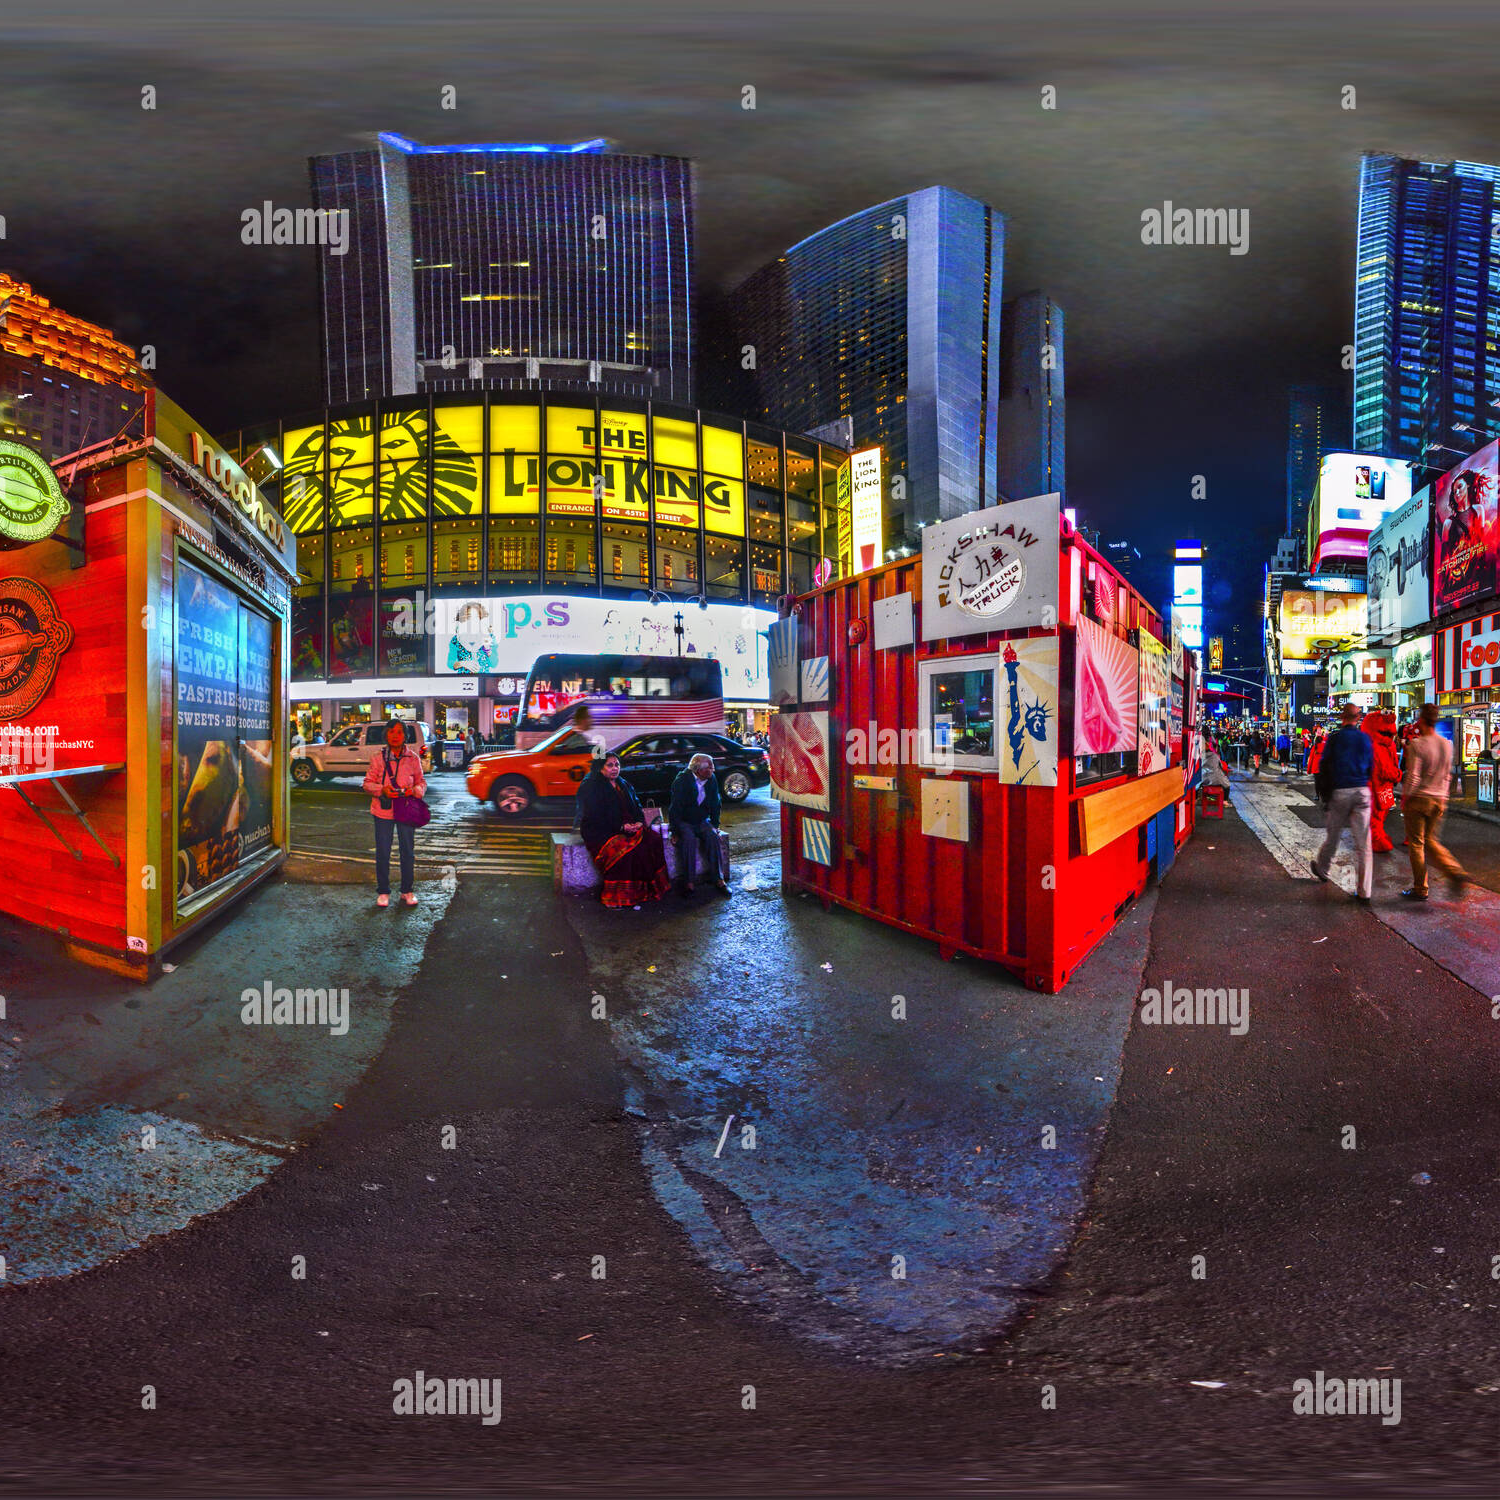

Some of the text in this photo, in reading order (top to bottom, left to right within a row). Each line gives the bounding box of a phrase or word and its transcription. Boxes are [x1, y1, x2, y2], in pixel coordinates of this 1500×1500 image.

[576, 426, 646, 450] THE
[855, 467, 877, 482] LION
[858, 459, 873, 468] THE
[503, 447, 731, 508] LION KING
[854, 479, 880, 493] KING
[190, 431, 287, 554] nuchas
[551, 504, 681, 522] ENTRANCE ON 45TH STREET
[973, 575, 1020, 611] TRUCK
[178, 617, 235, 651] FRESH
[178, 682, 240, 707] PASTRIE
[177, 711, 221, 728] SWEETS
[244, 823, 272, 847] nuchas
